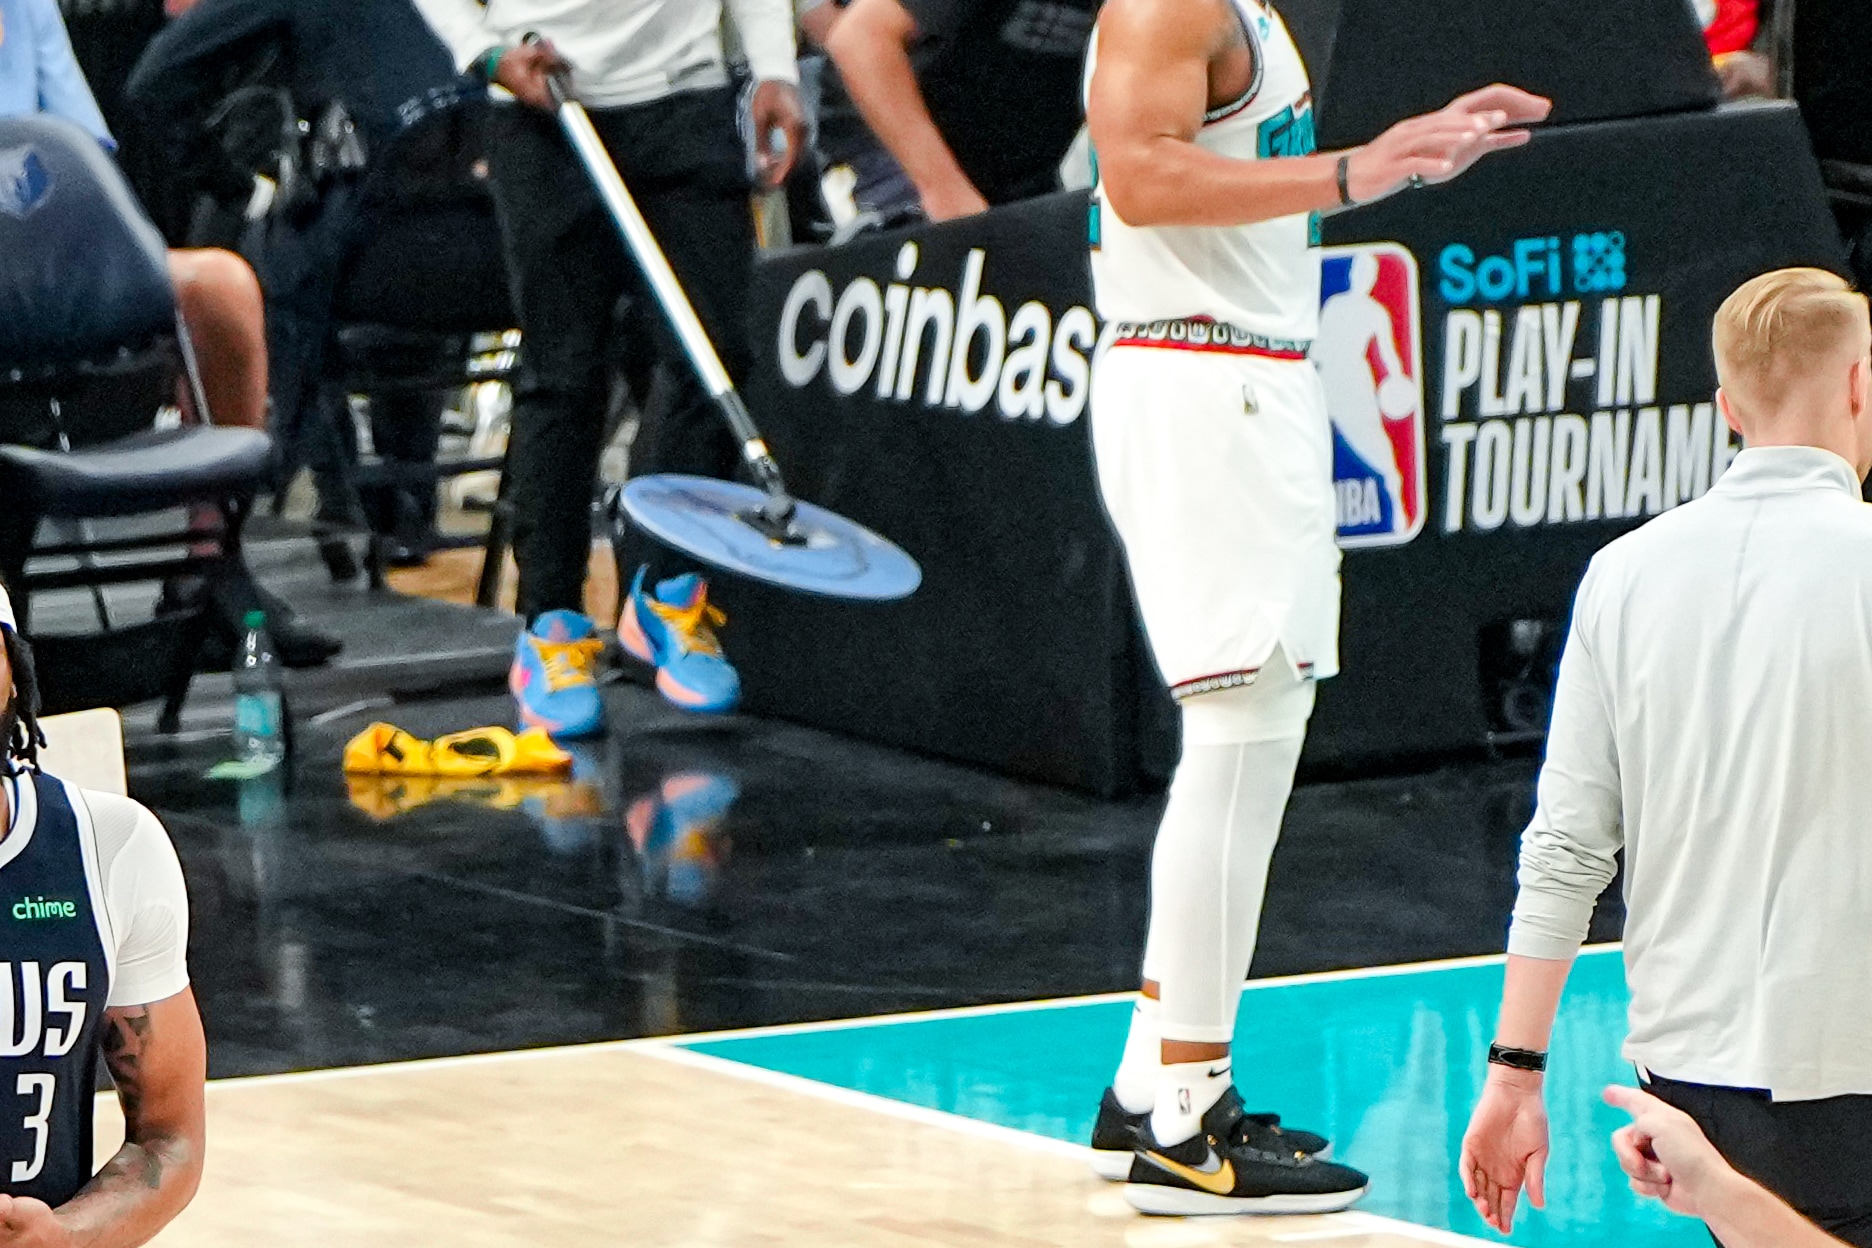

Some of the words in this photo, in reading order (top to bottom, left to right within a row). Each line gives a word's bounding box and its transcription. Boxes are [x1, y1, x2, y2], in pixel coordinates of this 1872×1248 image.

[1439, 236, 1560, 303] SoFi
[779, 240, 1108, 425] coinbas
[1442, 294, 1661, 420] PLAY-IN
[12, 896, 77, 920] chime
[11, 1072, 56, 1183] 3
